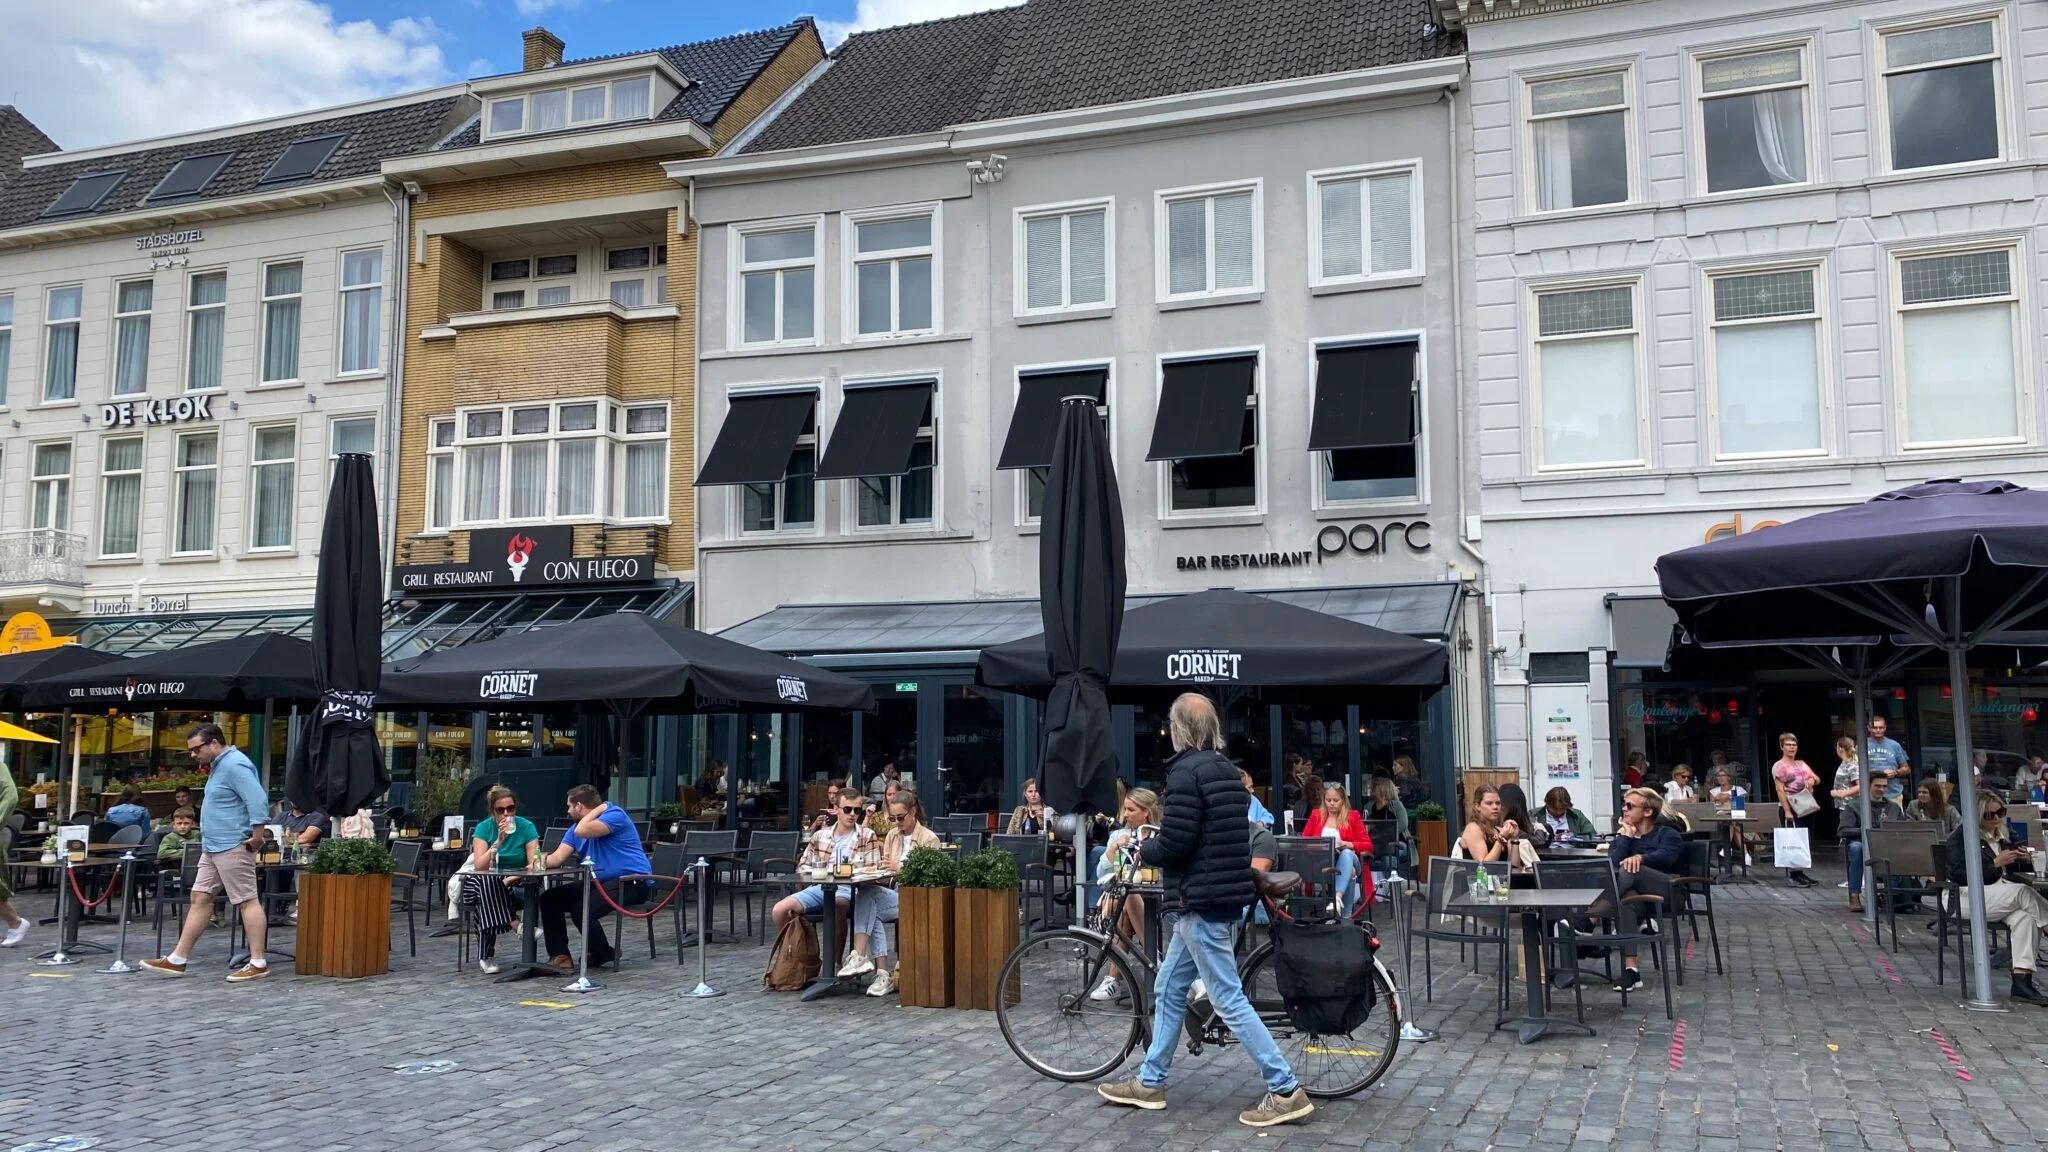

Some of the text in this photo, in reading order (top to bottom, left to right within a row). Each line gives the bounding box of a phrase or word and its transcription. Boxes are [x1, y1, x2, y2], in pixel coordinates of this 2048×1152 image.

[135, 230, 203, 249] STADSHOTEL
[101, 395, 211, 427] DE KLOK
[1176, 521, 1431, 570] BAR RESTAURANT parc
[402, 558, 638, 587] GRILL RESTAURANT CON FUEGO
[92, 593, 189, 614] Lunch Borrel
[1167, 653, 1242, 680] CORNET
[137, 683, 156, 695] CON
[159, 682, 185, 694] FUEGO
[480, 674, 538, 698] CORNET
[776, 678, 808, 701] CORNET
